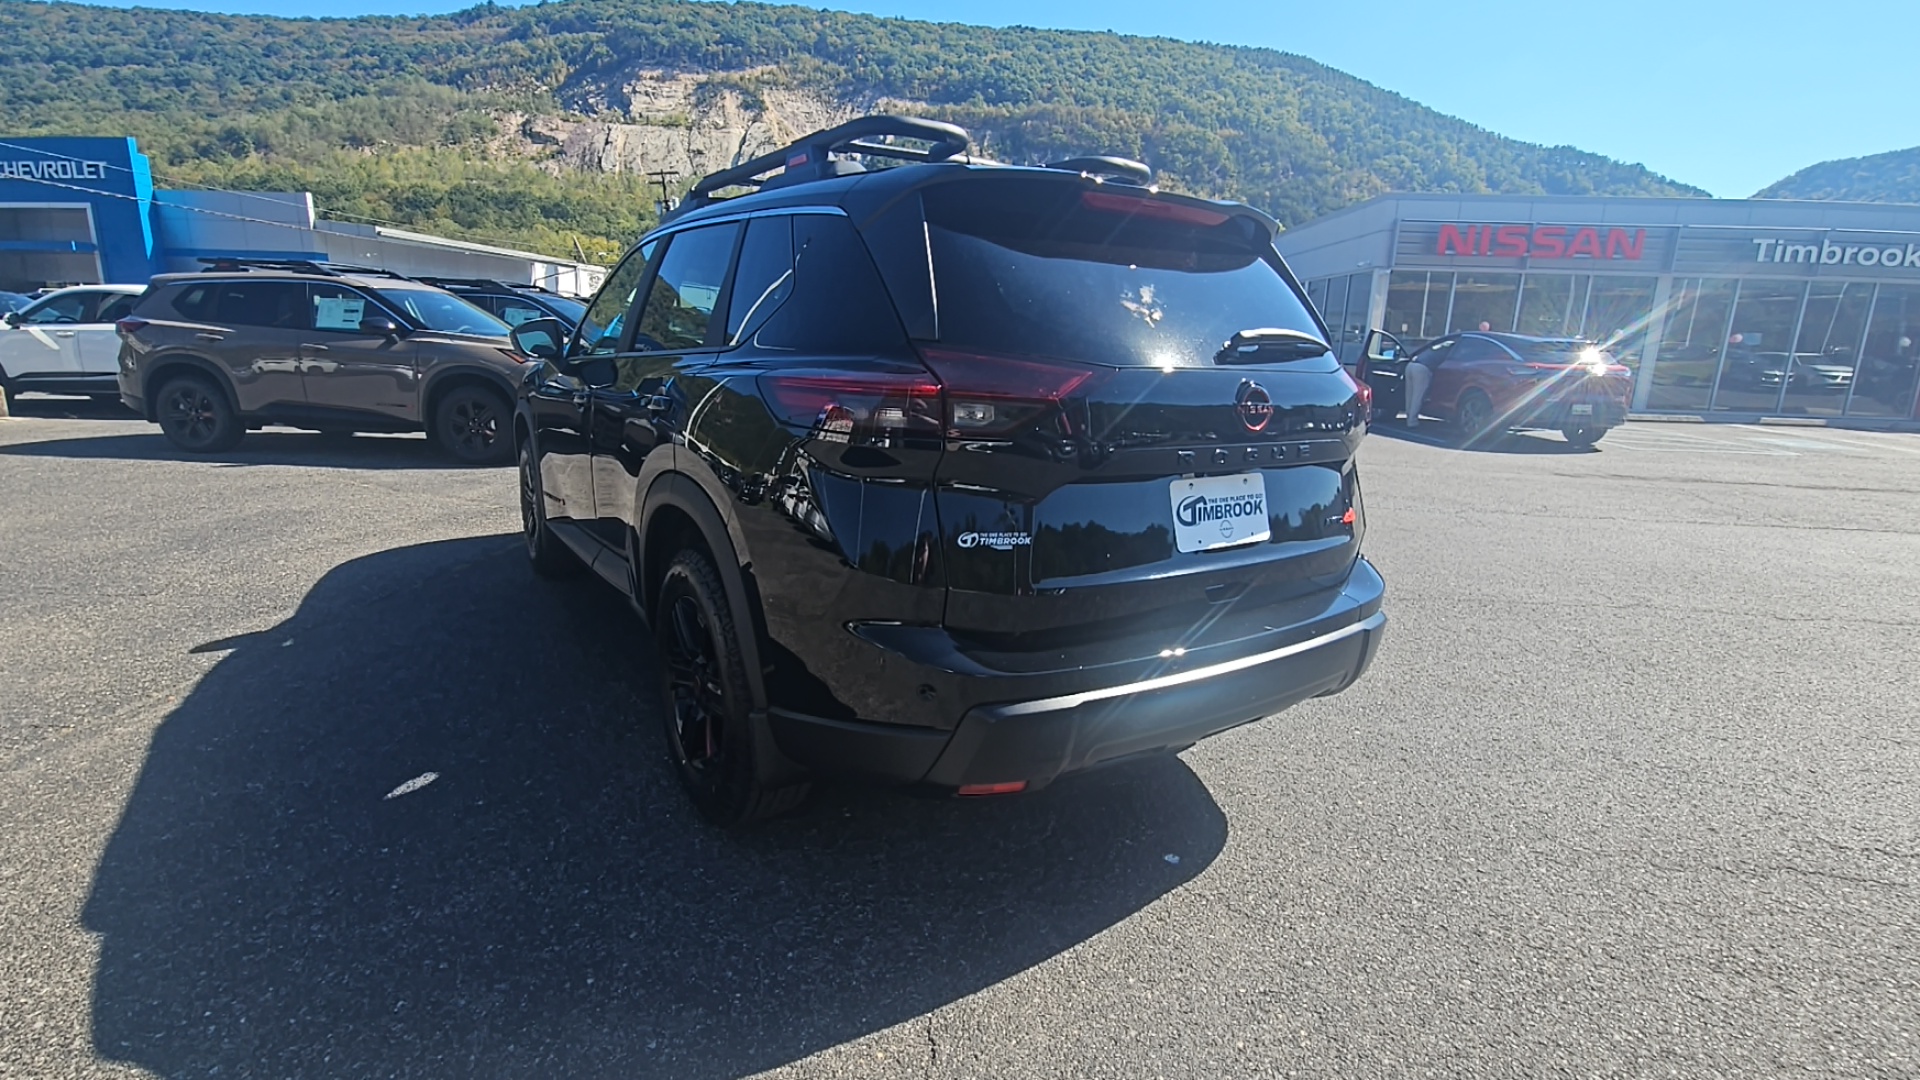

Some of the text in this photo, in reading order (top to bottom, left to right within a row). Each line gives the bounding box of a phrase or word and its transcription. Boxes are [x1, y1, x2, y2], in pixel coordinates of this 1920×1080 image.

[1437, 224, 1646, 260] NISSAN
[1752, 238, 1920, 267] Timbrook
[980, 537, 1032, 546] TIMBROOK
